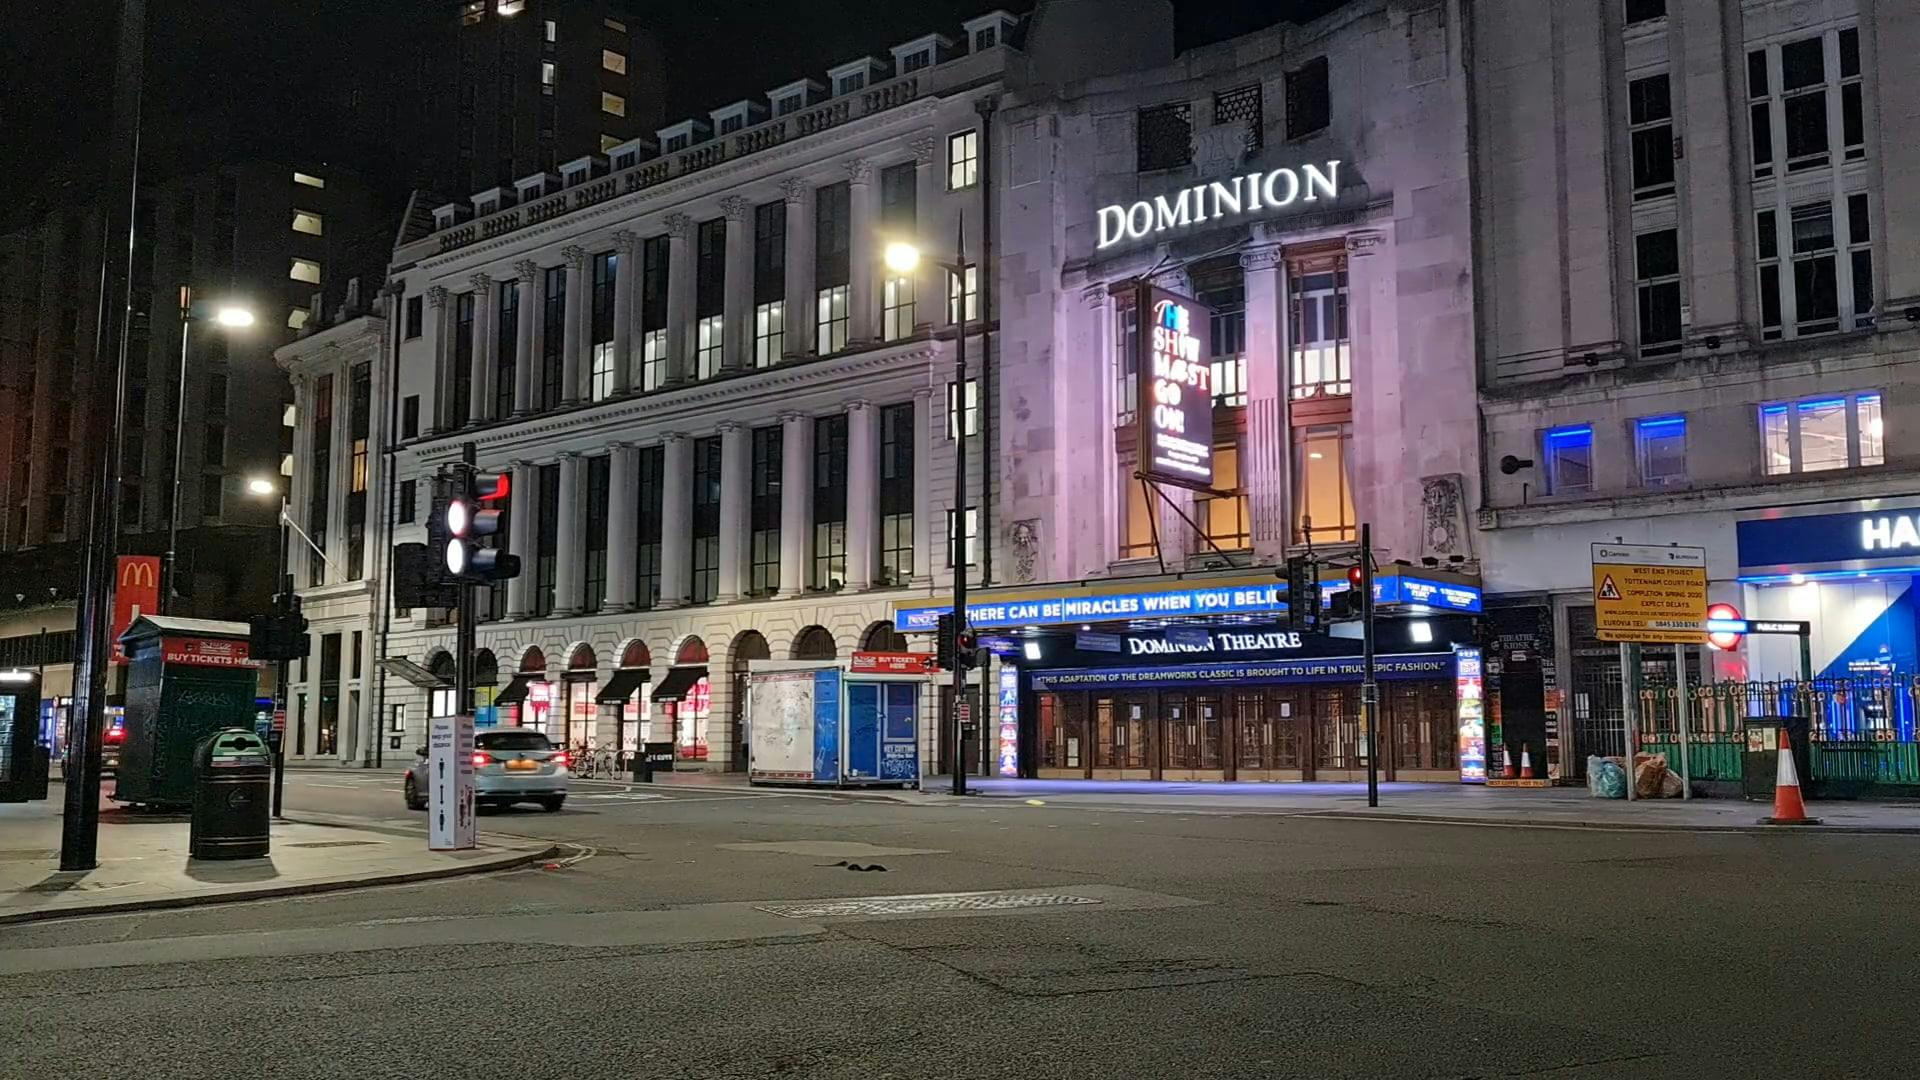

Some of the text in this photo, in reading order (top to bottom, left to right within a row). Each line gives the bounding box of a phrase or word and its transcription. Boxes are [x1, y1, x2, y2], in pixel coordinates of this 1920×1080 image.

[1096, 160, 1341, 250] DOMINION
[1153, 326, 1200, 364] SHOW
[1153, 351, 1210, 391] MUST
[1154, 378, 1181, 406] GO
[1862, 515, 1920, 550] HA
[1632, 567, 1651, 575] WEST
[1624, 578, 1662, 586] TOTTENHAM
[1626, 589, 1663, 597] COMPLETION
[1664, 590, 1686, 598] SPRING
[966, 608, 1006, 622] THERE
[1009, 605, 1038, 619] CAN
[1043, 603, 1061, 616] BE
[1066, 598, 1138, 616] MIRACLES
[1143, 594, 1191, 611] WHEN
[1195, 591, 1229, 608] YOU
[1218, 632, 1303, 651] THEATRE
[1503, 641, 1530, 650] KIOSK
[167, 653, 189, 662] BUY
[190, 654, 233, 665] TICKETS
[1059, 674, 1107, 683] ADAPTATION
[1121, 673, 1137, 681] THE
[1138, 671, 1197, 680] DREAMWORKS
[1199, 669, 1234, 678] CLASSIC
[1236, 669, 1245, 677] IS
[1247, 668, 1288, 677] BROUGHT
[1292, 667, 1304, 675] TO
[1306, 666, 1326, 675] LIFE
[1327, 665, 1338, 674] IN
[1372, 664, 1393, 673] EPIC
